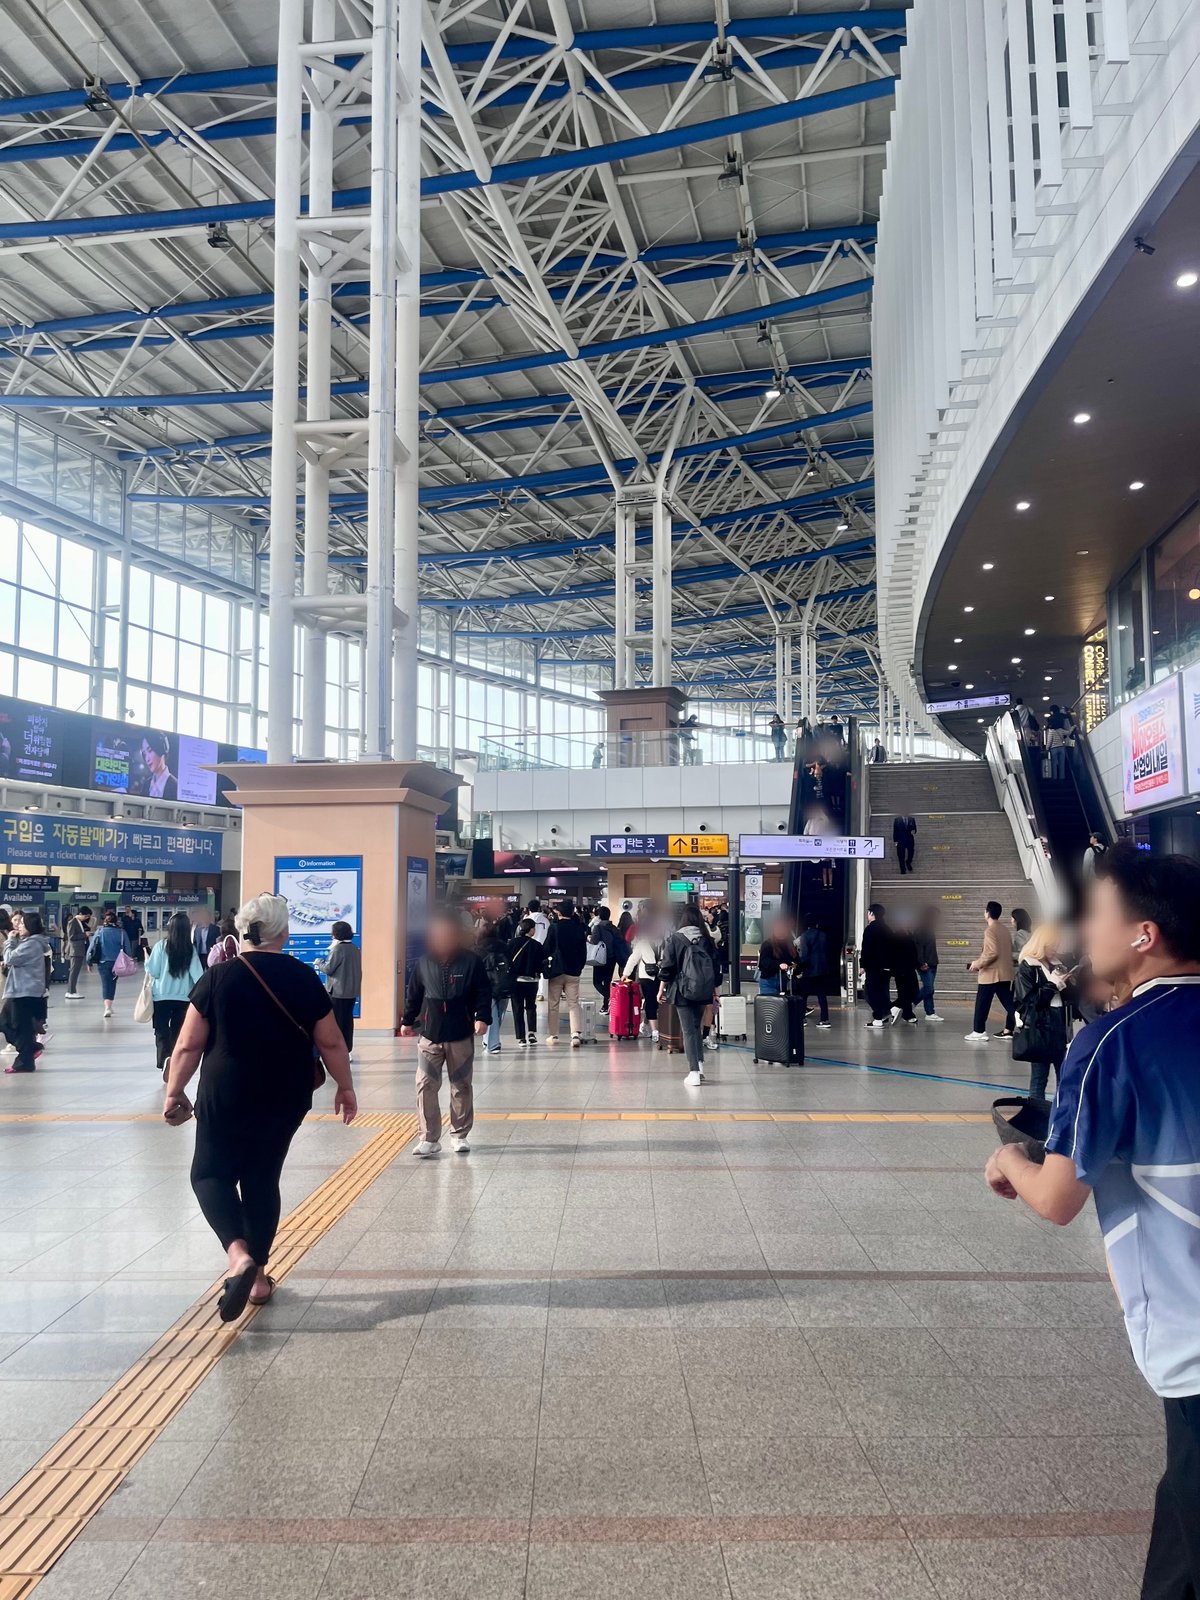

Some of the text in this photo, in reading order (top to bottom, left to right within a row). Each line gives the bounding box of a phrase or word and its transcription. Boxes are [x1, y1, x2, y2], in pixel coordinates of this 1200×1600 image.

[1083, 645, 1094, 690] CONNECT
[95, 757, 129, 774] 대한민국
[3, 819, 215, 856] 구입은 자동발매기가 빠르고 편리합니다.
[627, 838, 655, 848] 타는 곳
[7, 847, 32, 857] Please
[34, 850, 48, 858] use
[56, 850, 76, 860] ticket
[78, 852, 107, 862] machine
[109, 853, 118, 862] for
[126, 855, 143, 864] quick
[144, 857, 175, 866] purchase.
[3, 893, 33, 901] Available
[131, 894, 151, 903] Foreign
